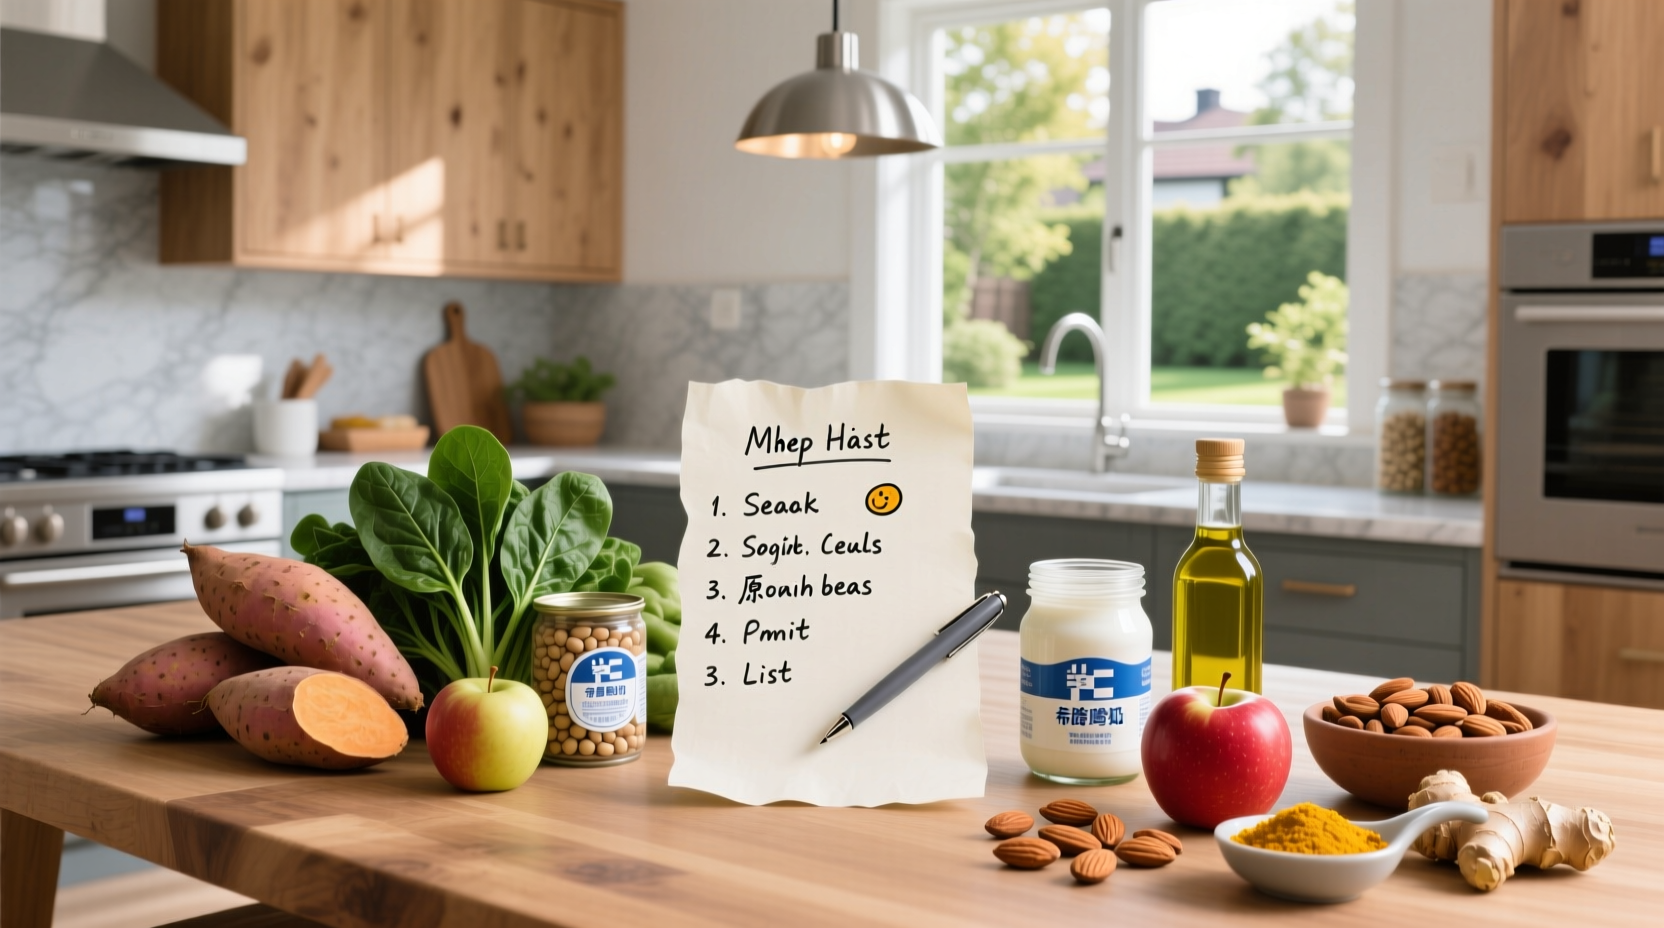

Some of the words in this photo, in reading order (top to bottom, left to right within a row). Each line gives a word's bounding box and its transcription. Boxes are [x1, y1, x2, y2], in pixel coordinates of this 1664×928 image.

[744, 424, 814, 467] Mhep
[711, 495, 727, 517] 1.
[743, 491, 820, 517] Seaak
[706, 538, 729, 558] 2.
[706, 579, 726, 600] 3.
[821, 573, 873, 597] beas
[704, 622, 726, 645] 4.
[704, 665, 726, 687] 3.
[743, 660, 793, 686] List
